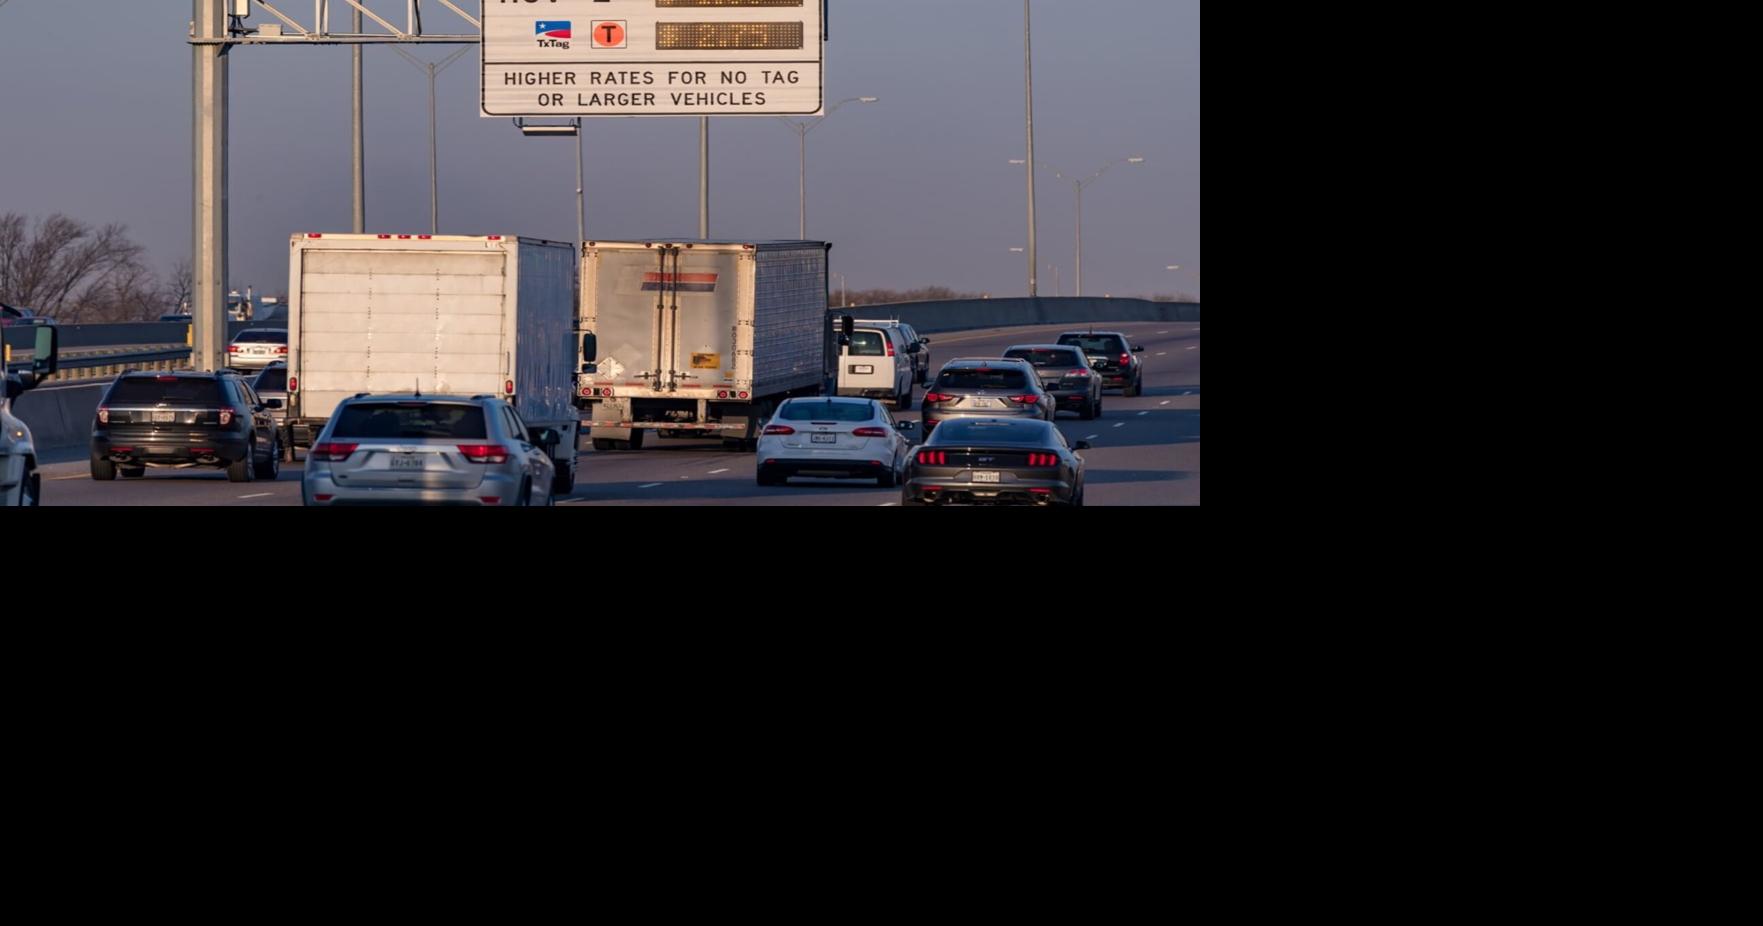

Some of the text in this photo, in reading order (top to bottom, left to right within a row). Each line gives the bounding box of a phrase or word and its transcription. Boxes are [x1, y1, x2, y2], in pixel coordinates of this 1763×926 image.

[601, 26, 616, 43] T
[537, 39, 569, 49] TxTag
[505, 71, 798, 85] HIGHER RATES FOR NO TAG
[538, 92, 765, 106] OR LARGER VEHICLES
